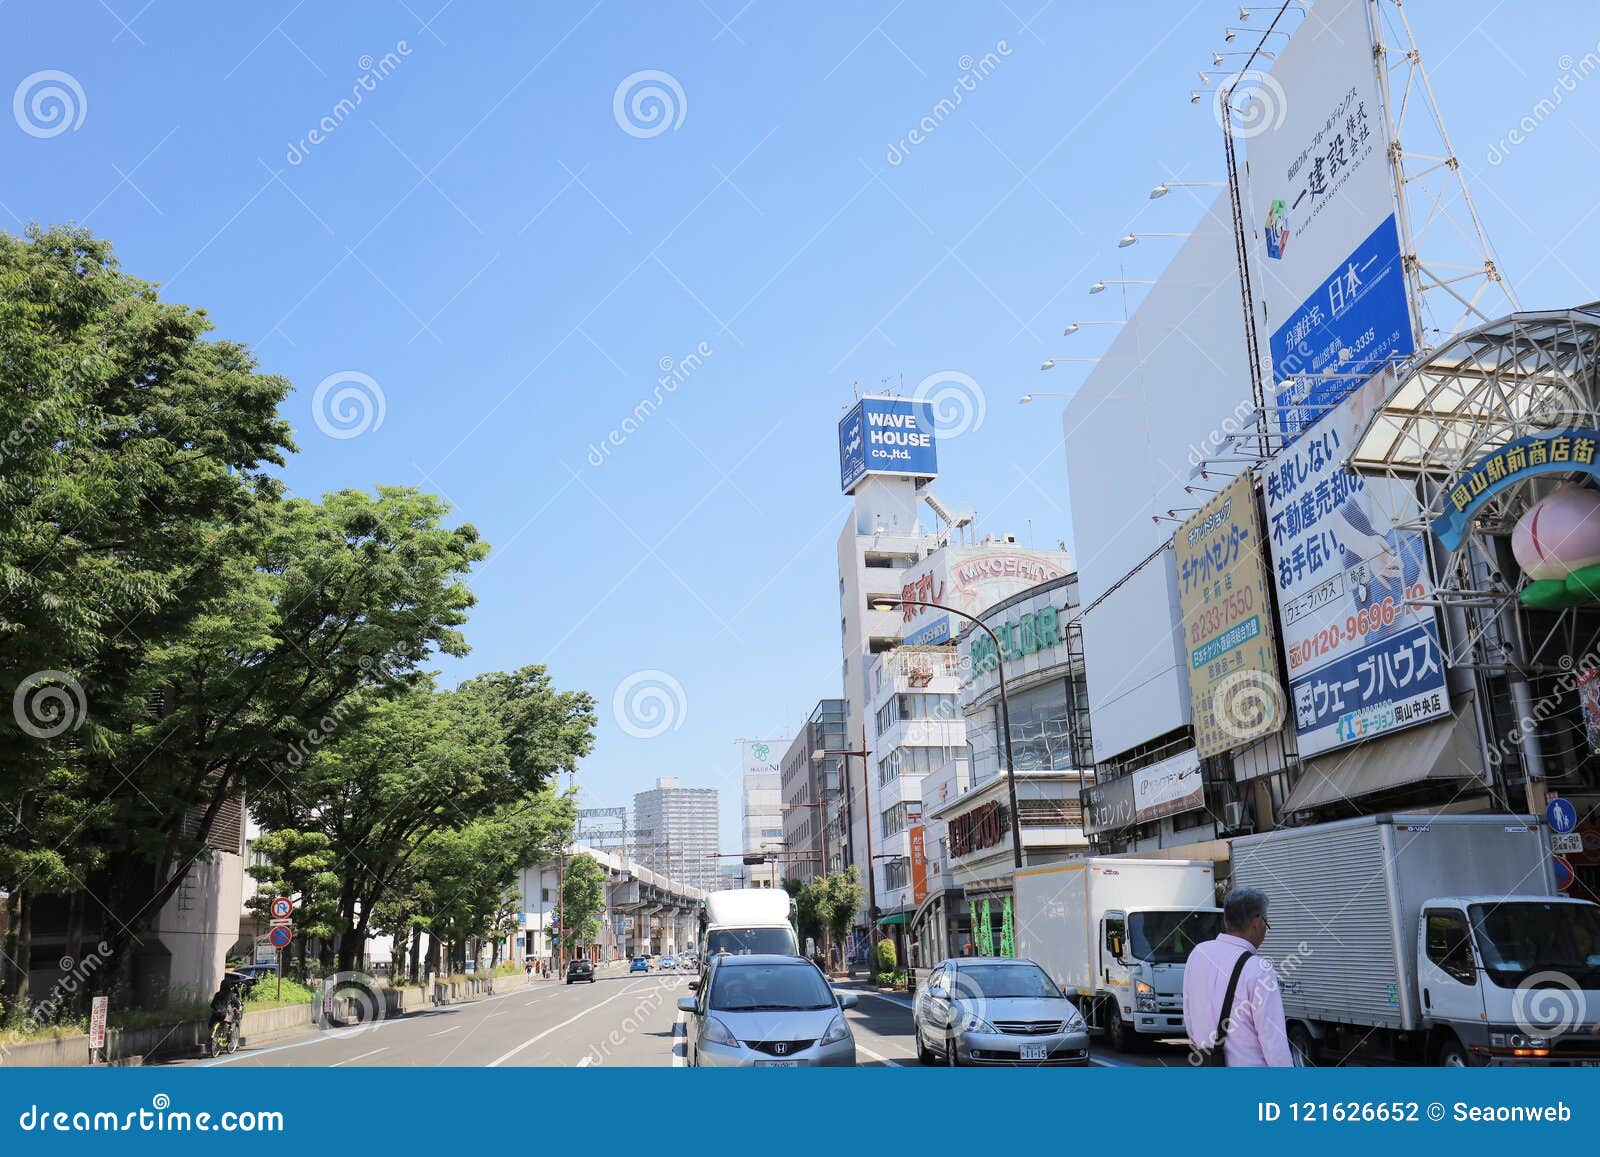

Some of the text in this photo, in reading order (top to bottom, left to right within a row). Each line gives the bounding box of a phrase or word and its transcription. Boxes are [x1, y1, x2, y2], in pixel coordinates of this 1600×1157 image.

[1328, 254, 1378, 317] 日本一
[867, 412, 916, 429] WAVE
[870, 430, 931, 448] HOUSE
[1267, 428, 1340, 508] 失敗しない
[1450, 436, 1596, 513] 岡山駅前商店街
[1188, 498, 1232, 549] チケットショップ
[1183, 523, 1249, 594] チケットセンター
[1278, 528, 1345, 590] お手伝い。
[1287, 581, 1336, 621] ウェーブハウス
[1313, 635, 1439, 718] ウェーブハウス
[1394, 693, 1442, 723] 岡山中央店
